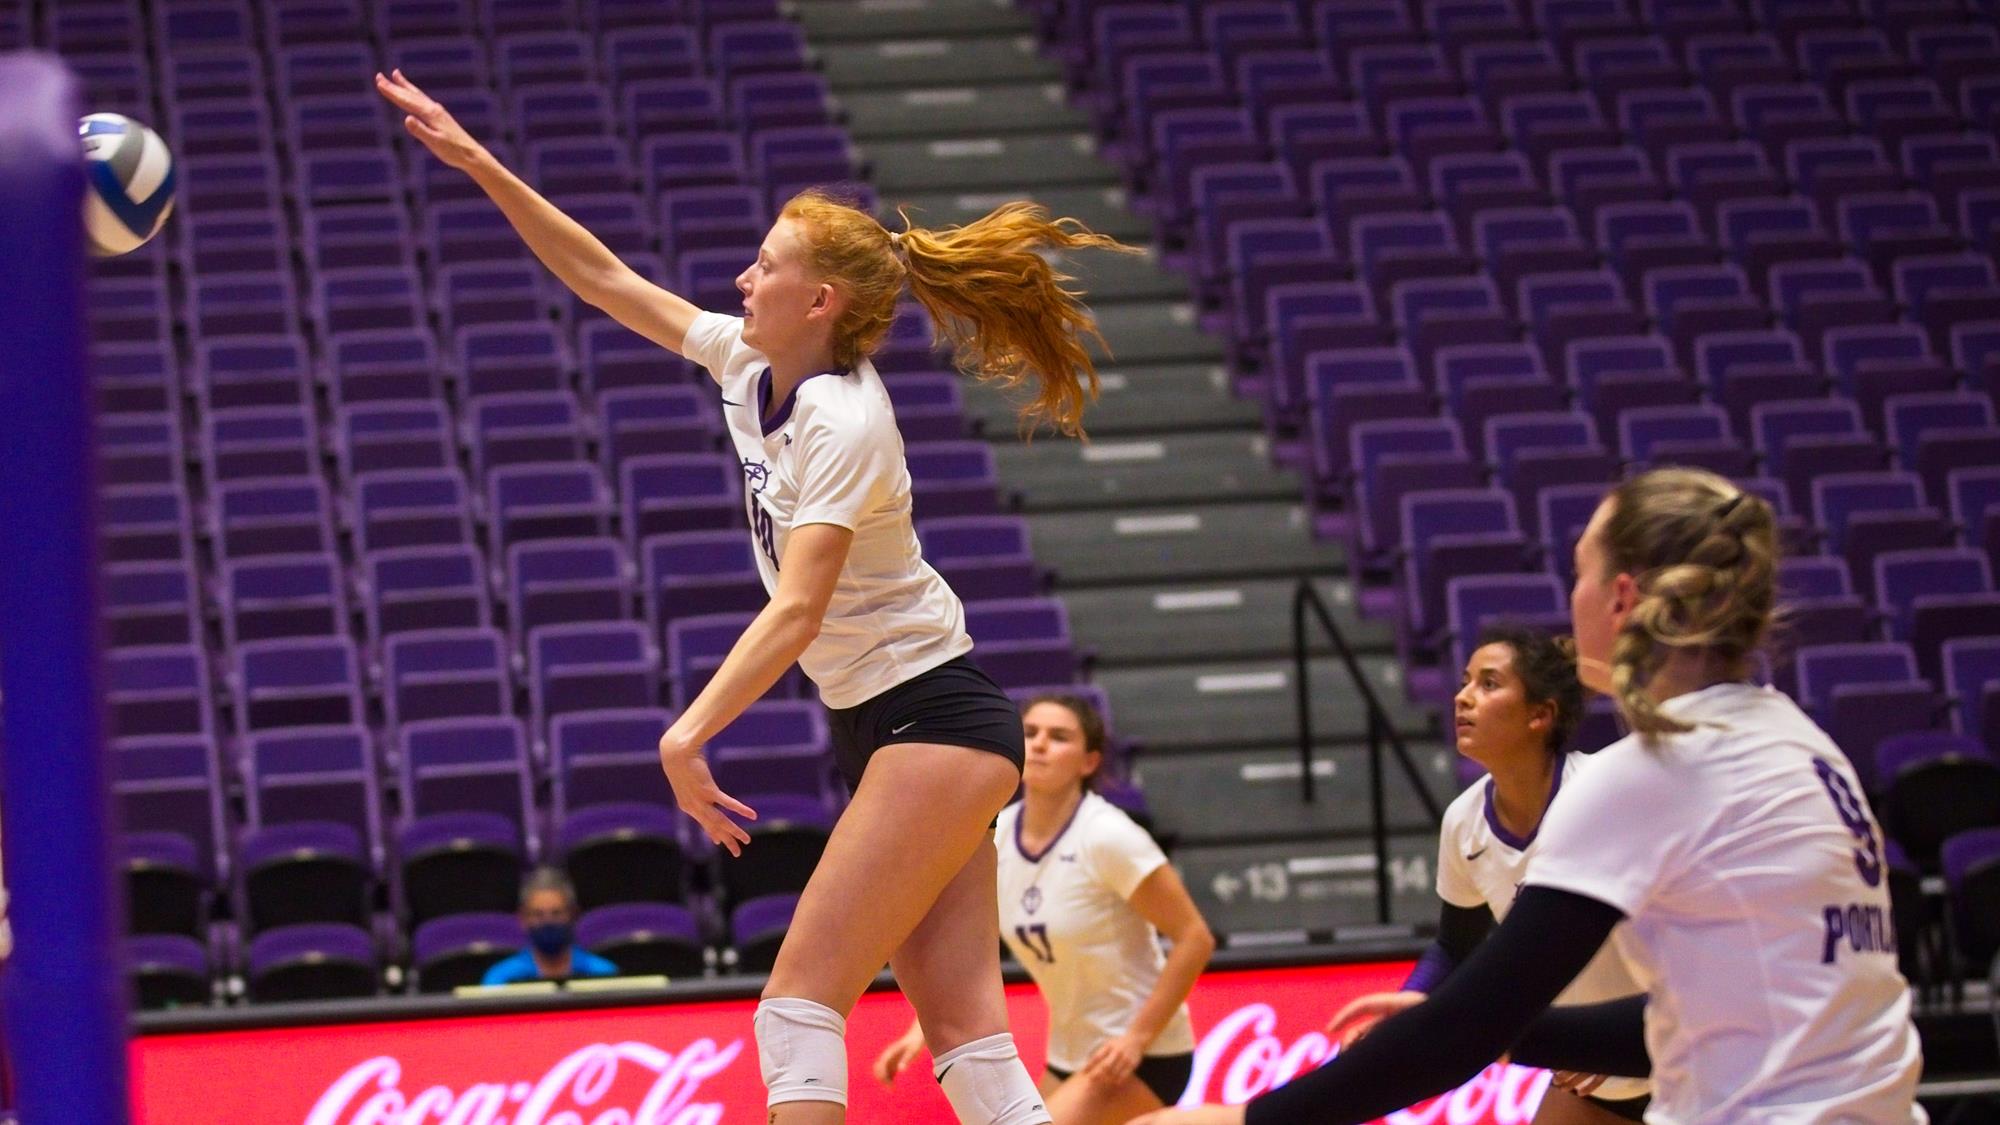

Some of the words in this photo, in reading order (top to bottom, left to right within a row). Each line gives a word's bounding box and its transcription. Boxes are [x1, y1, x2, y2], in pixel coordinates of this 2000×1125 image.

[1813, 757, 1880, 887] 9
[1246, 863, 1288, 900] 13
[1389, 856, 1429, 893] 14
[1015, 923, 1054, 963] 17
[1821, 903, 1898, 963] PORTL
[303, 1036, 744, 1125] Coca-Cl
